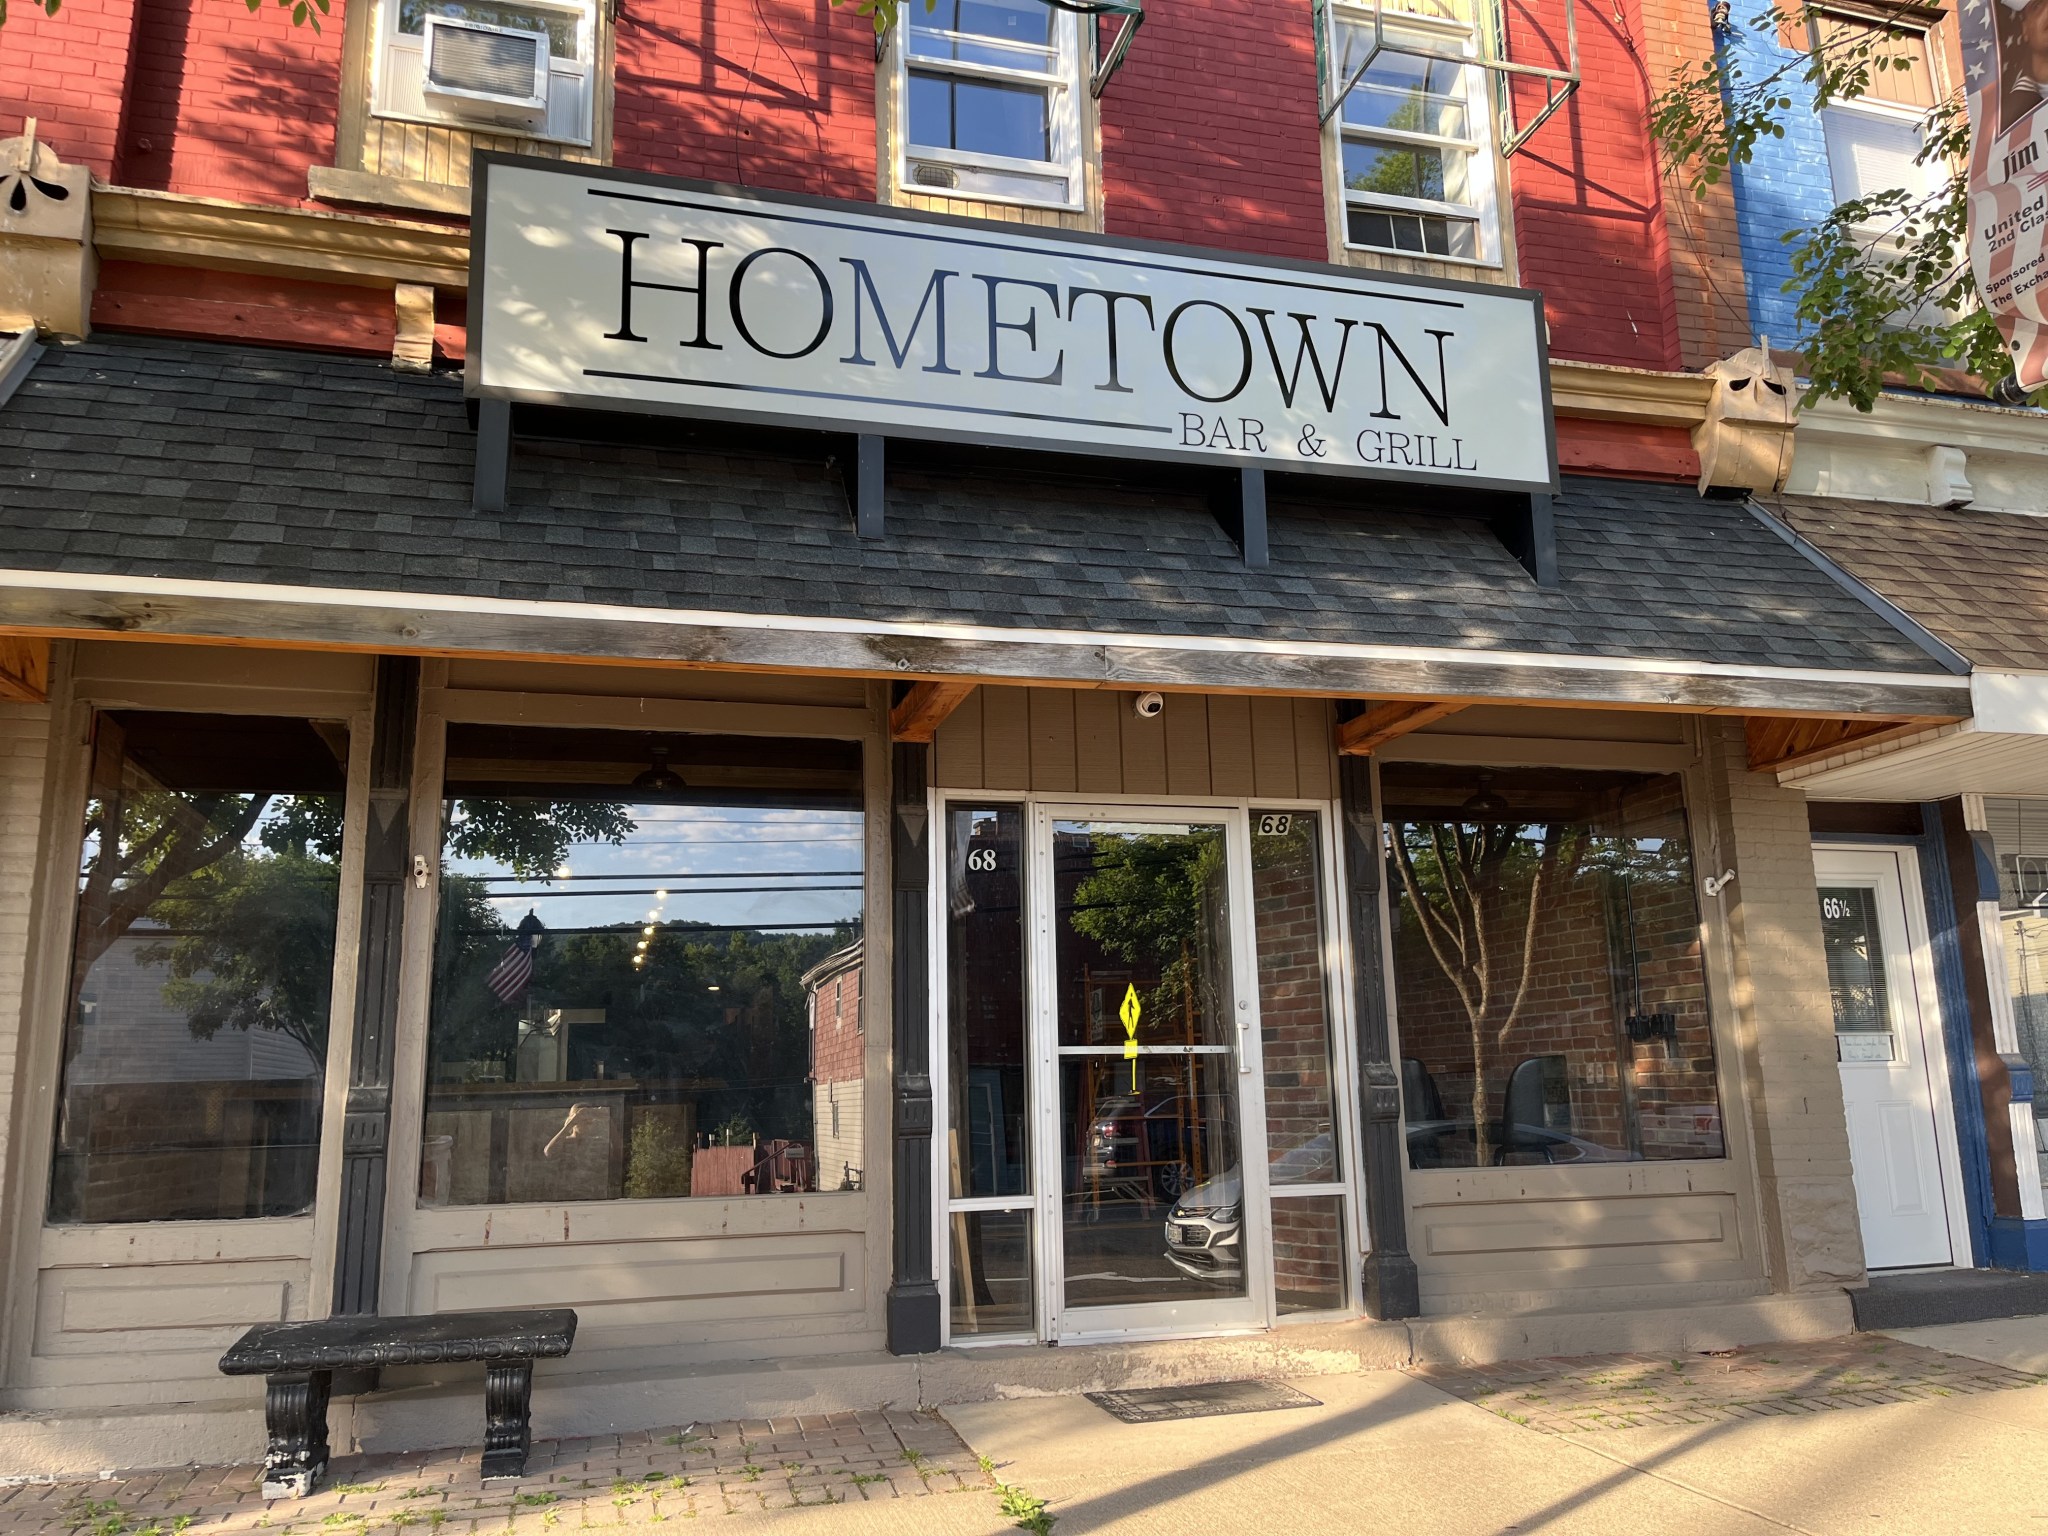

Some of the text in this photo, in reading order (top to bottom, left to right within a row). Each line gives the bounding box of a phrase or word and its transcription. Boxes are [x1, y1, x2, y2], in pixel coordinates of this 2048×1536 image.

[2002, 140, 2039, 185] Jim
[1985, 194, 2044, 240] United
[1988, 228, 2015, 253] 2nd
[1985, 252, 2045, 294] Sponsored
[1991, 292, 2013, 308] The
[603, 228, 1455, 426] HOMETOWN
[1178, 412, 1477, 471] BAR & GRILL
[1261, 815, 1289, 834] 68
[968, 848, 997, 871] 68
